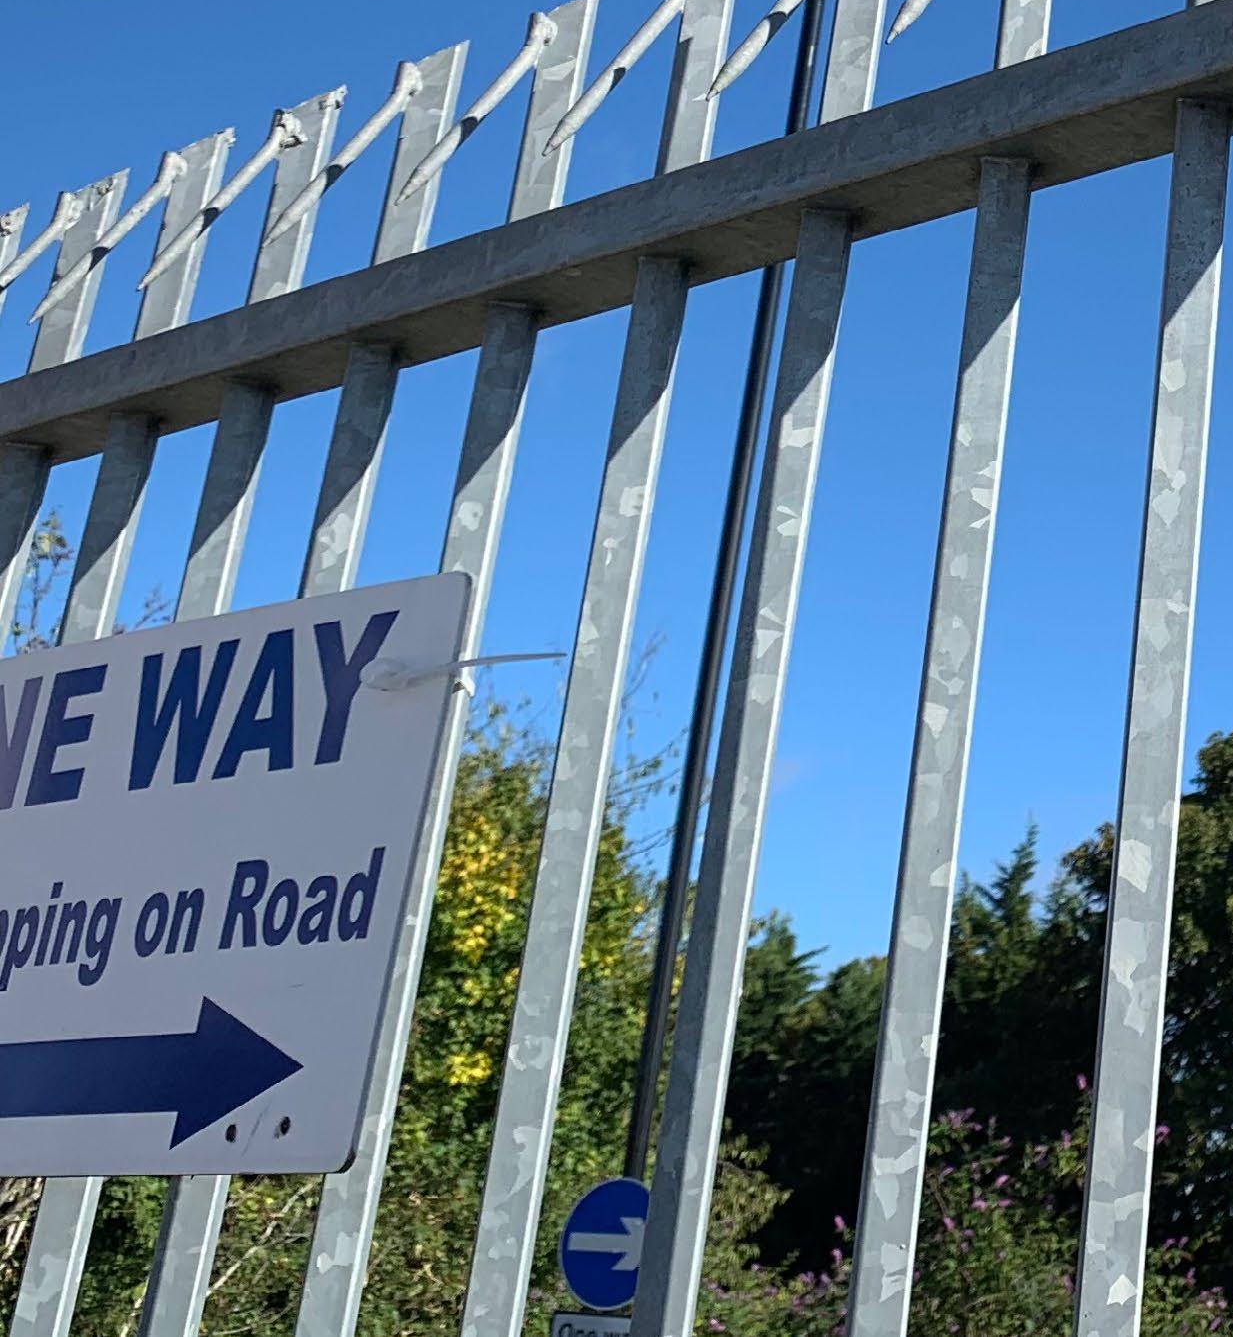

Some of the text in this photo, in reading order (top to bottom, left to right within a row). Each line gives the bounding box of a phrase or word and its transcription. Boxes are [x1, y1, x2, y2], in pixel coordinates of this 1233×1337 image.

[128, 610, 400, 791] WAY
[135, 887, 205, 958] on
[219, 847, 386, 950] Road
